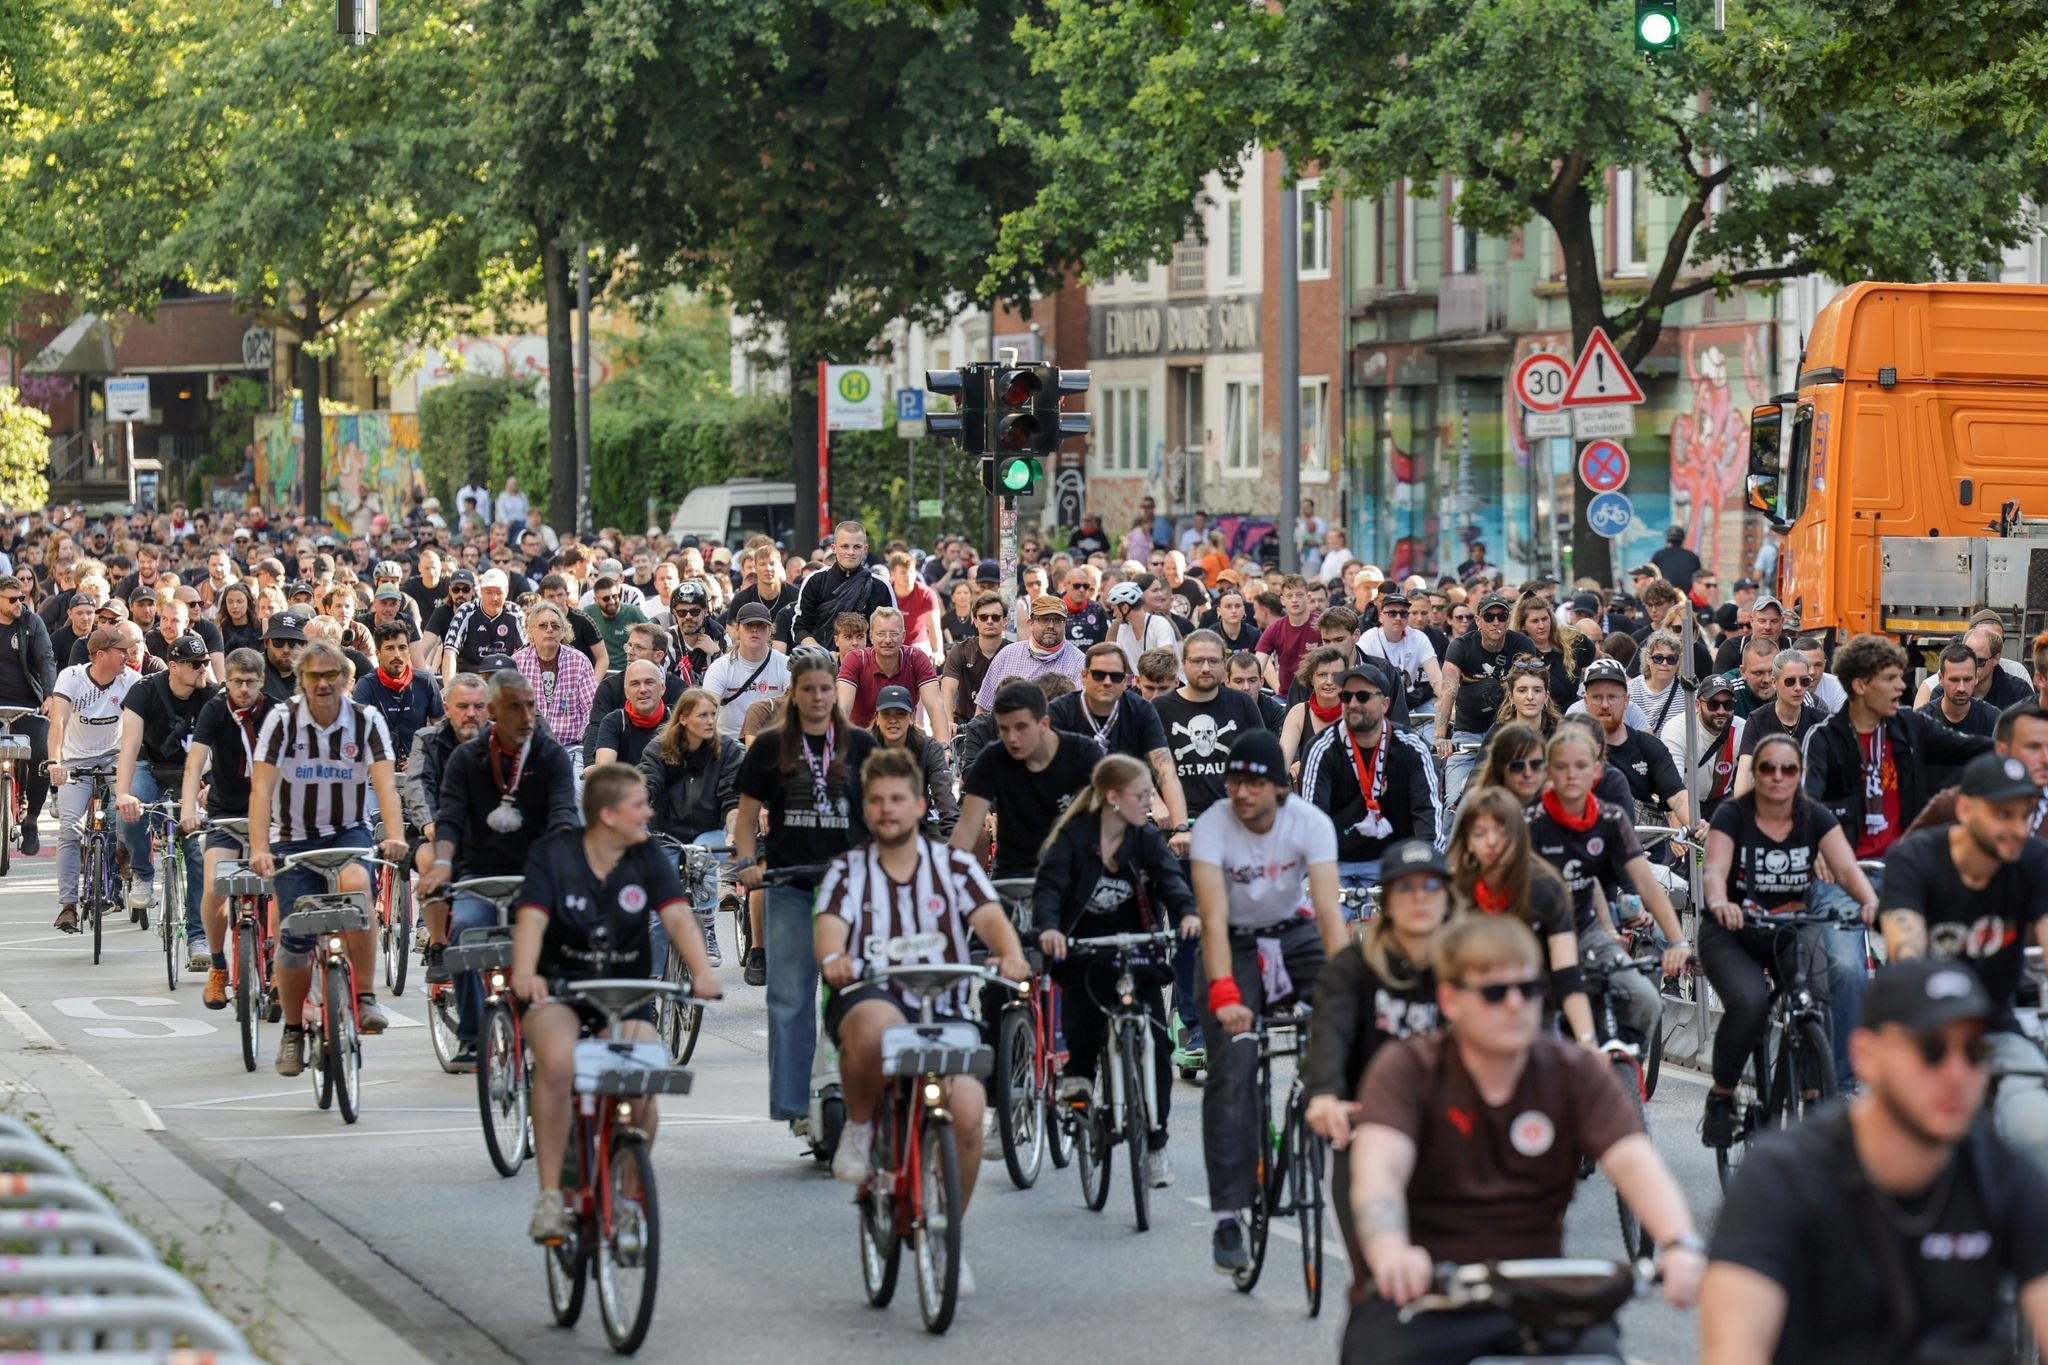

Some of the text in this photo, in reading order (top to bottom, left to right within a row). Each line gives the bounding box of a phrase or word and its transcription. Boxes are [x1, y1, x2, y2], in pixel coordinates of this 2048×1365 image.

[847, 378, 861, 395] H
[1529, 370, 1562, 395] 30
[901, 393, 916, 417] P
[295, 766, 313, 778] ein
